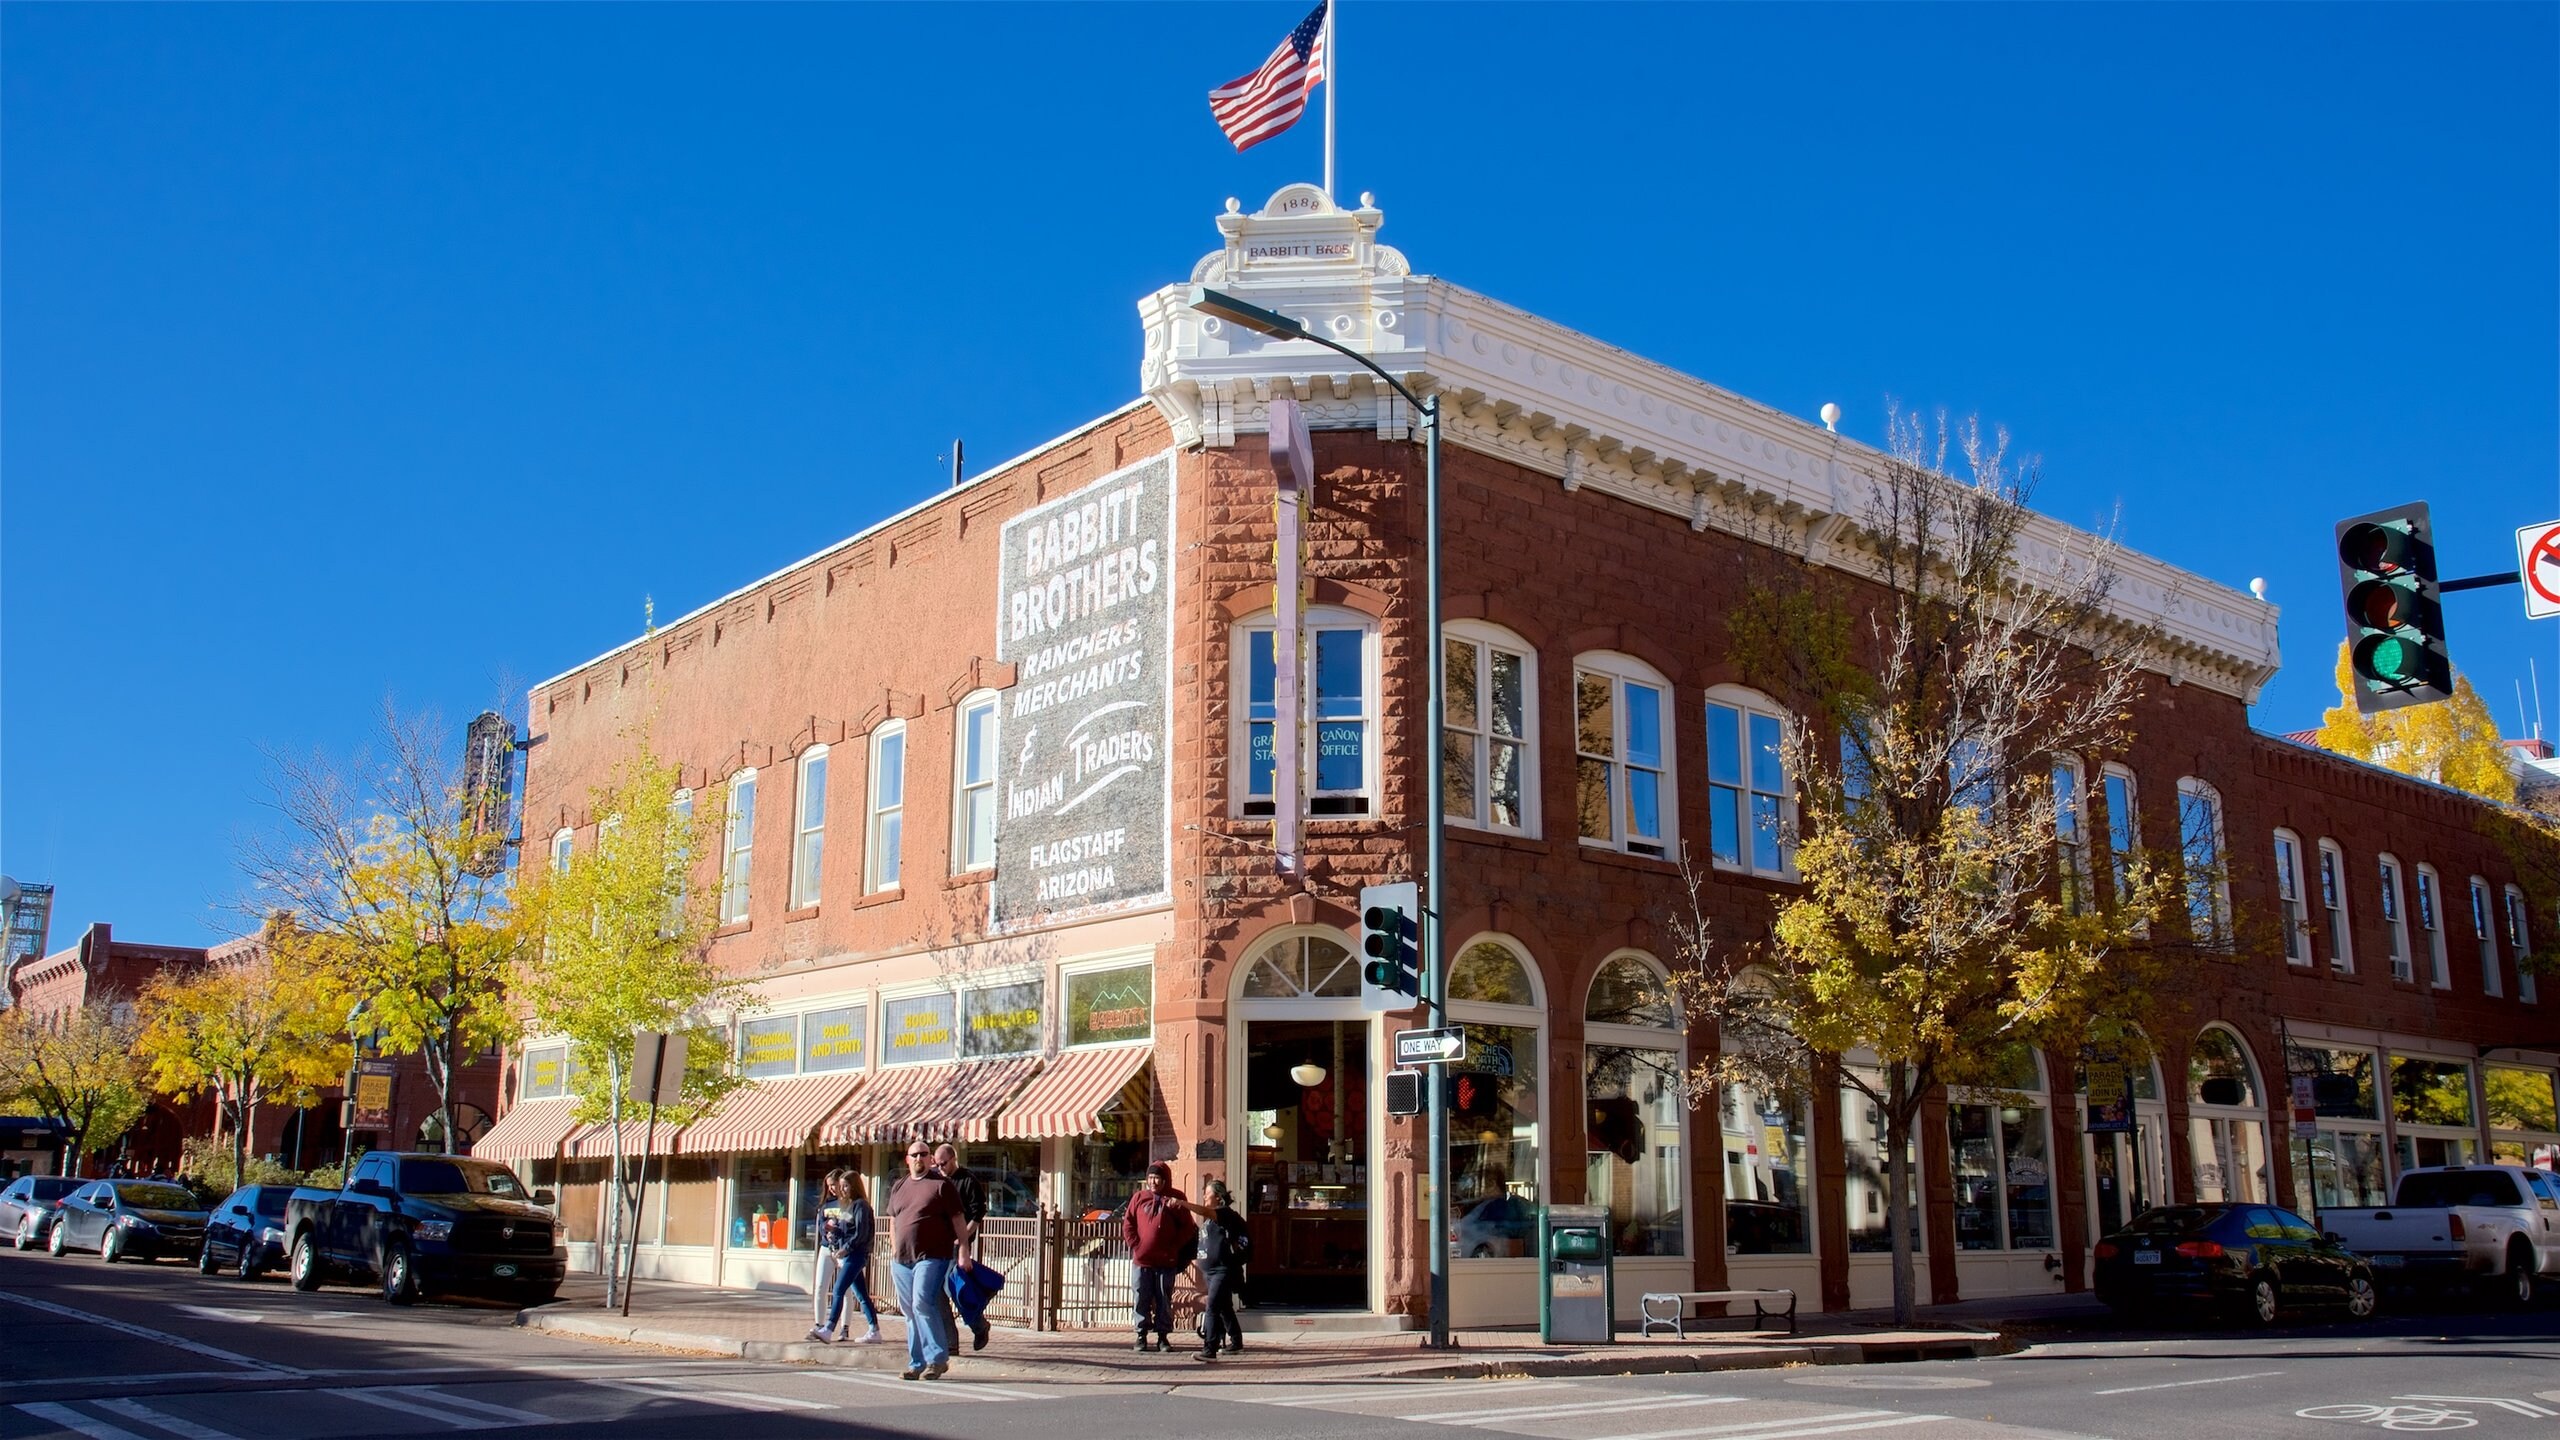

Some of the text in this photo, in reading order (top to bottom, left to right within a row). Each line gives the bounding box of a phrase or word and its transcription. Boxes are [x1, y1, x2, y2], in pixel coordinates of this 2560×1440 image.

[1283, 198, 1319, 212] 1888
[1250, 245, 1311, 257] BABBITT
[1025, 482, 1144, 577] BABBITT
[1011, 540, 1158, 642] BROTHERS
[1012, 650, 1142, 719] MERCHANTS
[1018, 723, 1038, 777] &
[1253, 735, 1275, 748] GRA
[1255, 744, 1359, 761] STA OFFICE
[1007, 724, 1153, 822] INDIAN TRADERS
[1030, 828, 1126, 870] FLAGSTAFF
[1037, 865, 1114, 902] ARIZONA
[904, 1012, 939, 1029] BOOKS
[748, 1031, 792, 1048] TECHNICAL
[823, 1023, 850, 1039] PACKS
[894, 1028, 949, 1048] AND MAPS
[810, 1039, 861, 1057] AND TENTS
[1403, 1039, 1442, 1053] ONE WAY
[1481, 1044, 1498, 1055] THE
[1467, 1055, 1498, 1065] NORTH
[2091, 1088, 2123, 1096] JOIN US
